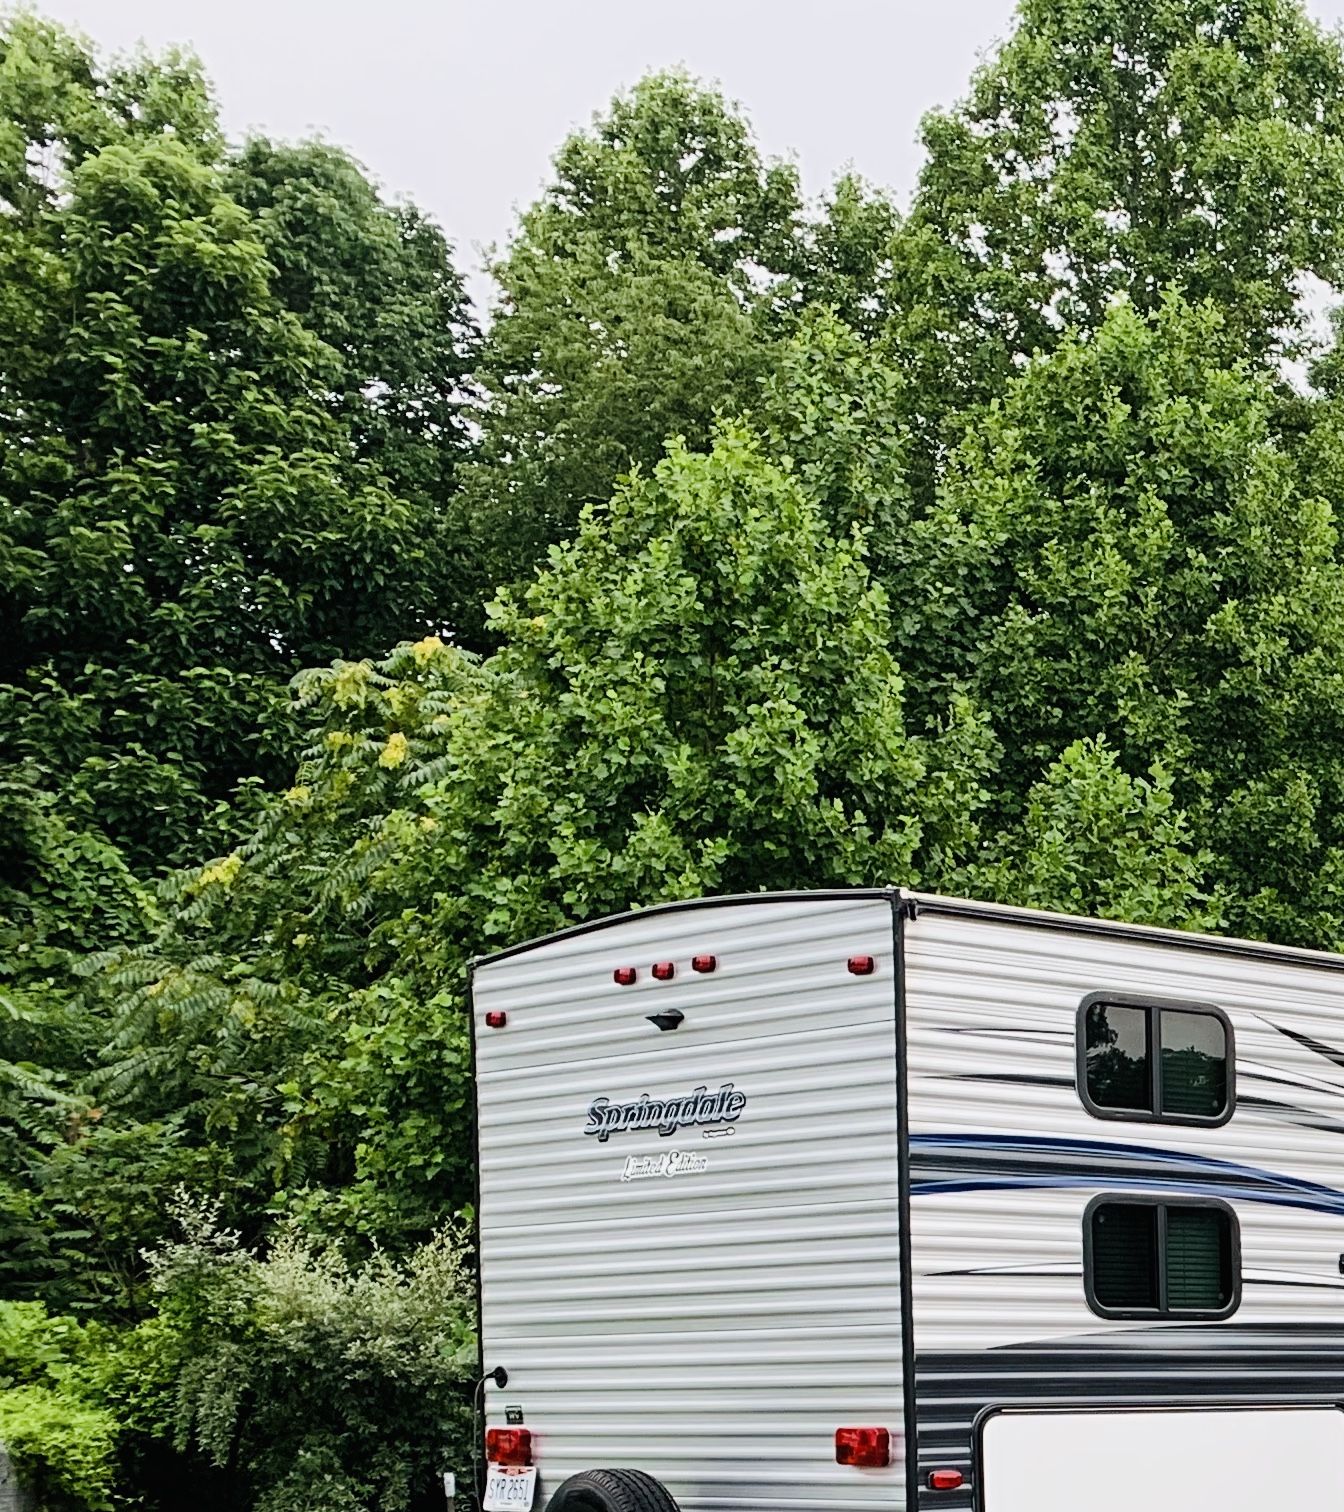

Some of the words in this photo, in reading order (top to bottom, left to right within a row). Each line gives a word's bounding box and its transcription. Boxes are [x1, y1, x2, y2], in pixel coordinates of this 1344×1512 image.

[584, 1083, 746, 1142] Springdale
[621, 1155, 664, 1181] Limited
[664, 1150, 707, 1177] Edition
[488, 1478, 507, 1500] SYR
[508, 1478, 529, 1501] 2651
